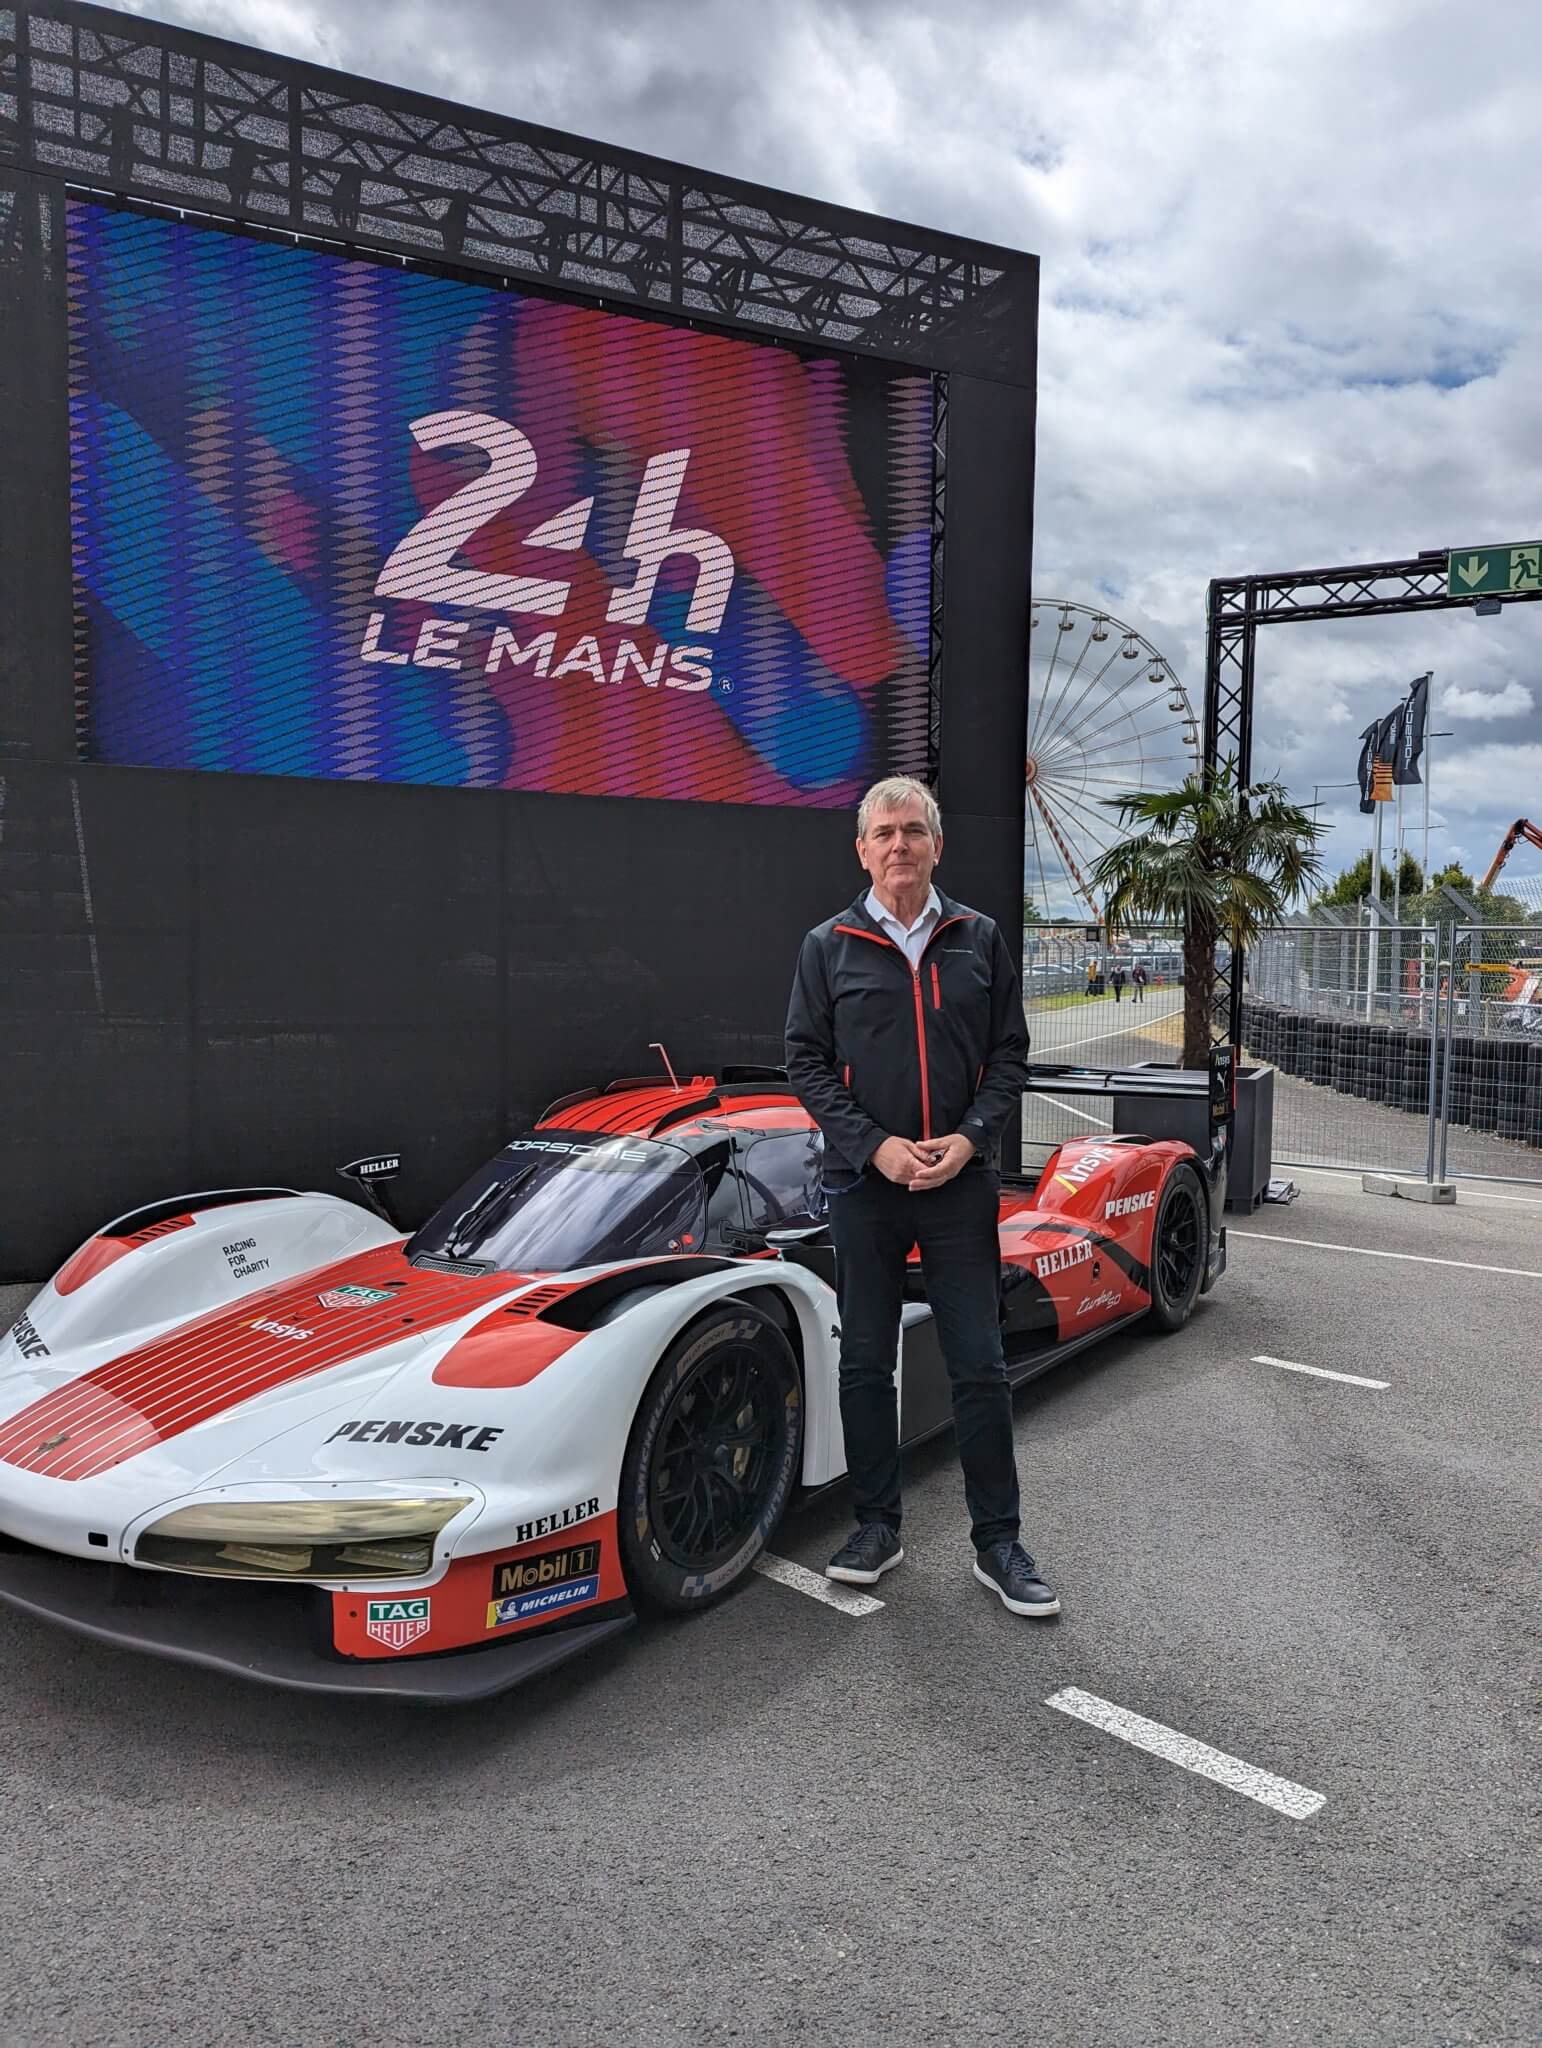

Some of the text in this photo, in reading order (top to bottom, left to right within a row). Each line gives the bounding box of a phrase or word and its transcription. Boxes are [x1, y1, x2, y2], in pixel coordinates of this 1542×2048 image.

[374, 410, 735, 634] 24h
[360, 613, 470, 670] LE
[484, 626, 714, 692] MANS
[360, 1159, 399, 1175] HELLER
[505, 1140, 648, 1163] PORSCHE
[1054, 1147, 1114, 1195] Ansys
[1105, 1190, 1156, 1220] PENSKE
[222, 1237, 257, 1256] RACING
[228, 1253, 248, 1268] FOR
[1035, 1239, 1094, 1279] HELLER
[233, 1258, 271, 1279] CHARITY
[11, 1311, 51, 1360] ENSKE
[322, 1420, 505, 1452] PENSKE
[638, 1378, 673, 1494] MICHELIN
[764, 1426, 797, 1530] MICHELIN
[516, 1497, 600, 1543] HELLER
[500, 1554, 567, 1593] Mobil
[372, 1601, 425, 1620] TAG
[520, 1584, 590, 1612] MICHELIN
[370, 1619, 427, 1646] HEUER
